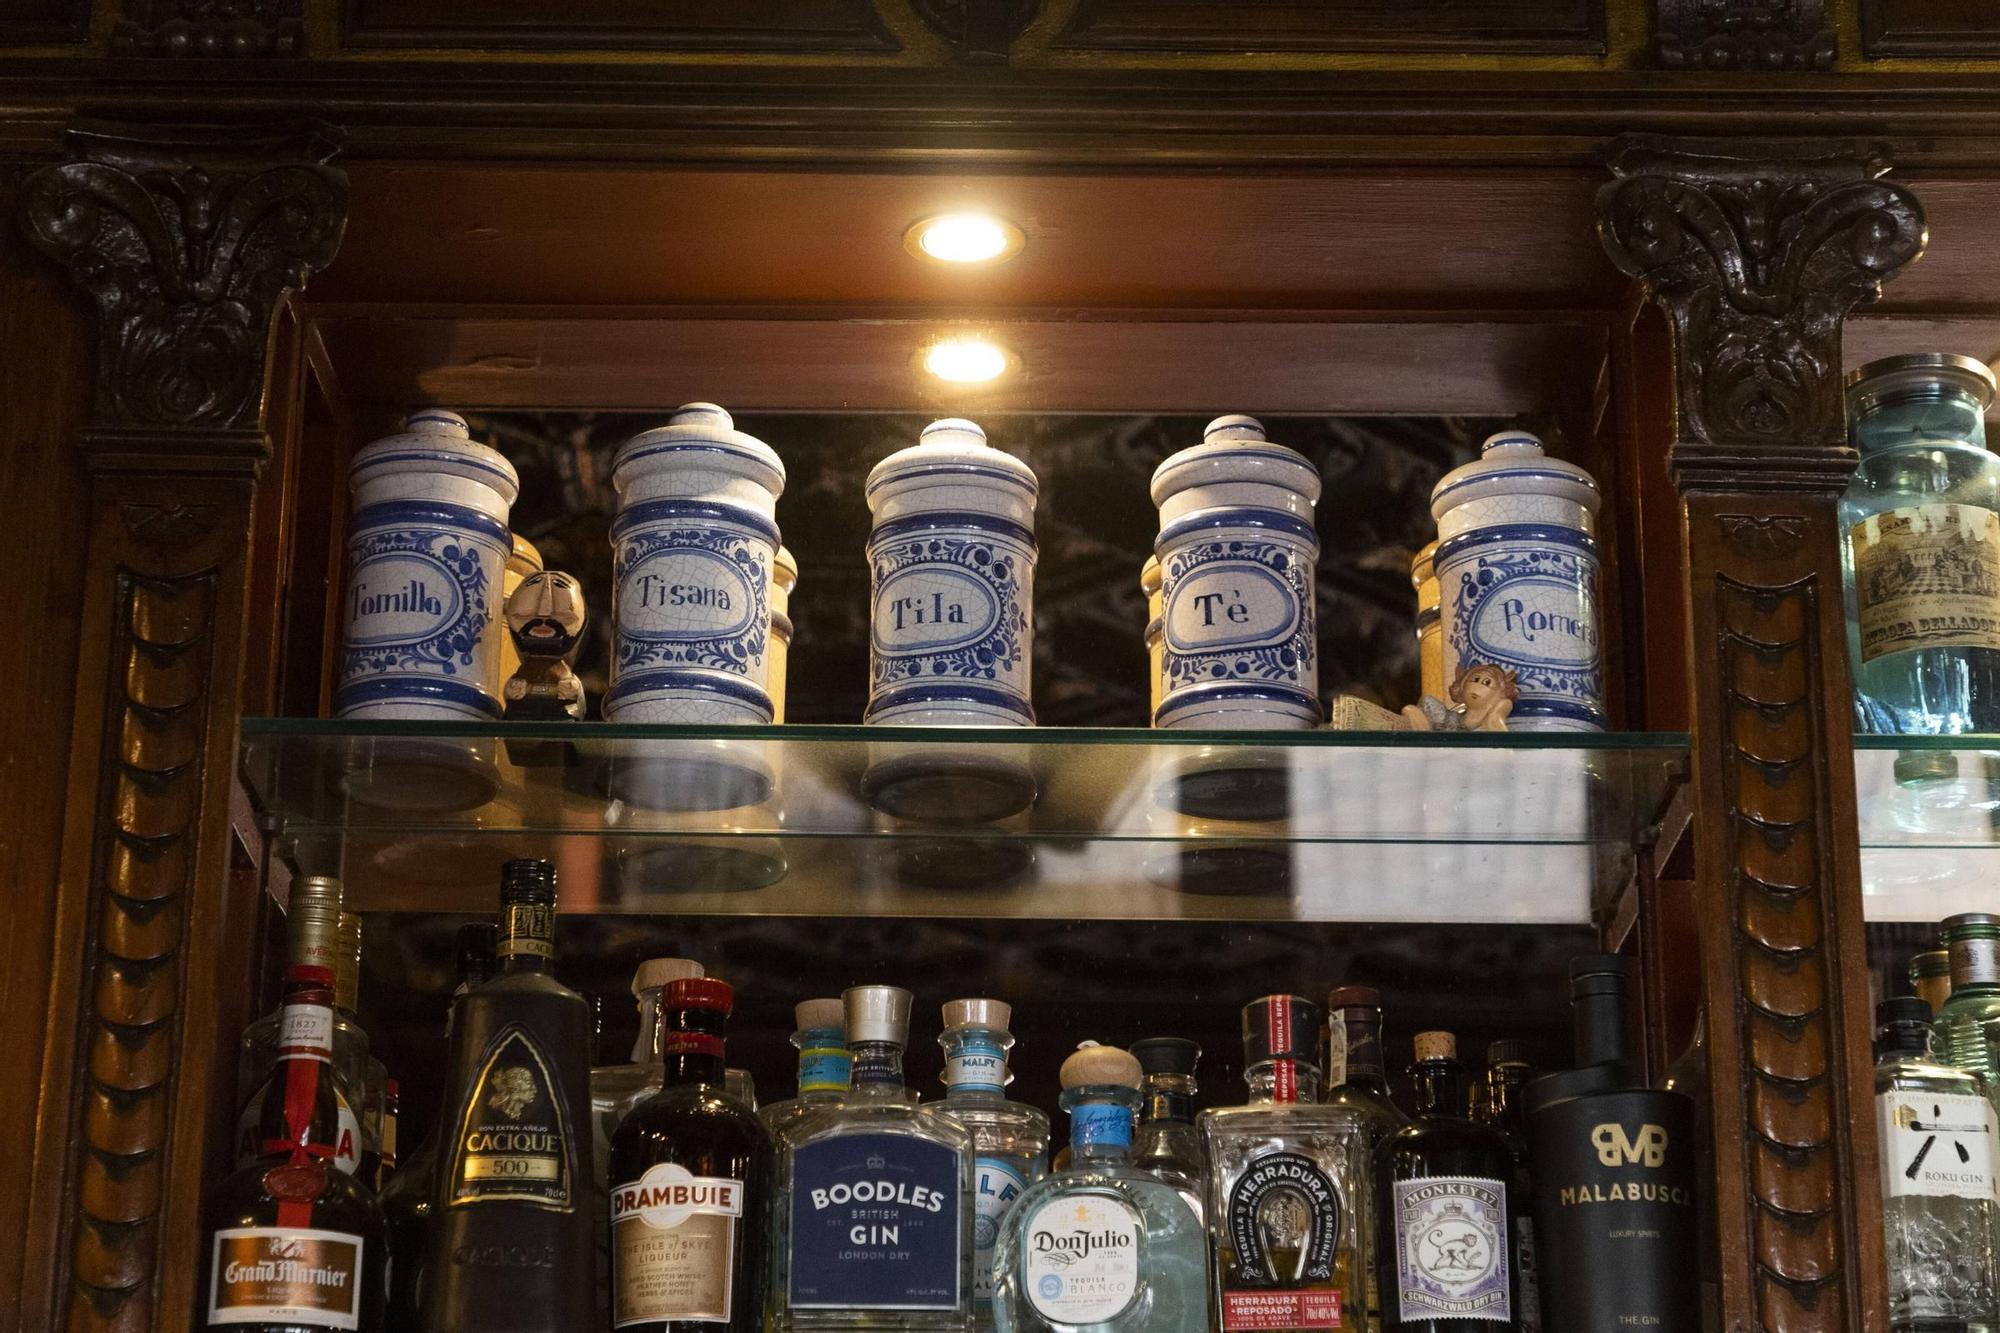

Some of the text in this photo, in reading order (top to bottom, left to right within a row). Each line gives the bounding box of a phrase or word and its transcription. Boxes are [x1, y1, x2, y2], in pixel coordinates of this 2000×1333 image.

[636, 574, 732, 610] Tisana
[890, 592, 969, 632] Tila
[1918, 615, 2000, 633] BELLADON
[962, 1058, 996, 1068] MALFY
[496, 1124, 520, 1132] EXTRA
[466, 1132, 559, 1152] CACIQUE
[493, 1160, 529, 1176] 500
[1239, 1164, 1328, 1203] HERRADURA
[1924, 1171, 1984, 1183] ROKU GIN
[613, 1185, 732, 1216] DRAMBUIE
[810, 1180, 945, 1213] BOODLES
[1407, 1183, 1498, 1206] MONKEY 47
[851, 1209, 899, 1220] BRITISH
[849, 1225, 899, 1246] GIN
[1236, 1217, 1252, 1264] TEQUILA
[1319, 1214, 1334, 1261] ORIGINAL
[639, 1252, 688, 1264] LIQUEUR
[838, 1250, 911, 1261] LONDON DRY
[1070, 1283, 1127, 1295] BLANCO
[1230, 1296, 1298, 1306] HERRADURA
[1305, 1296, 1337, 1304] TEQUILA
[1407, 1291, 1473, 1312] SCHWARZWALD
[1473, 1295, 1489, 1309] DRY
[1236, 1306, 1293, 1316] REPOSADO
[1619, 1315, 1639, 1325] THE
